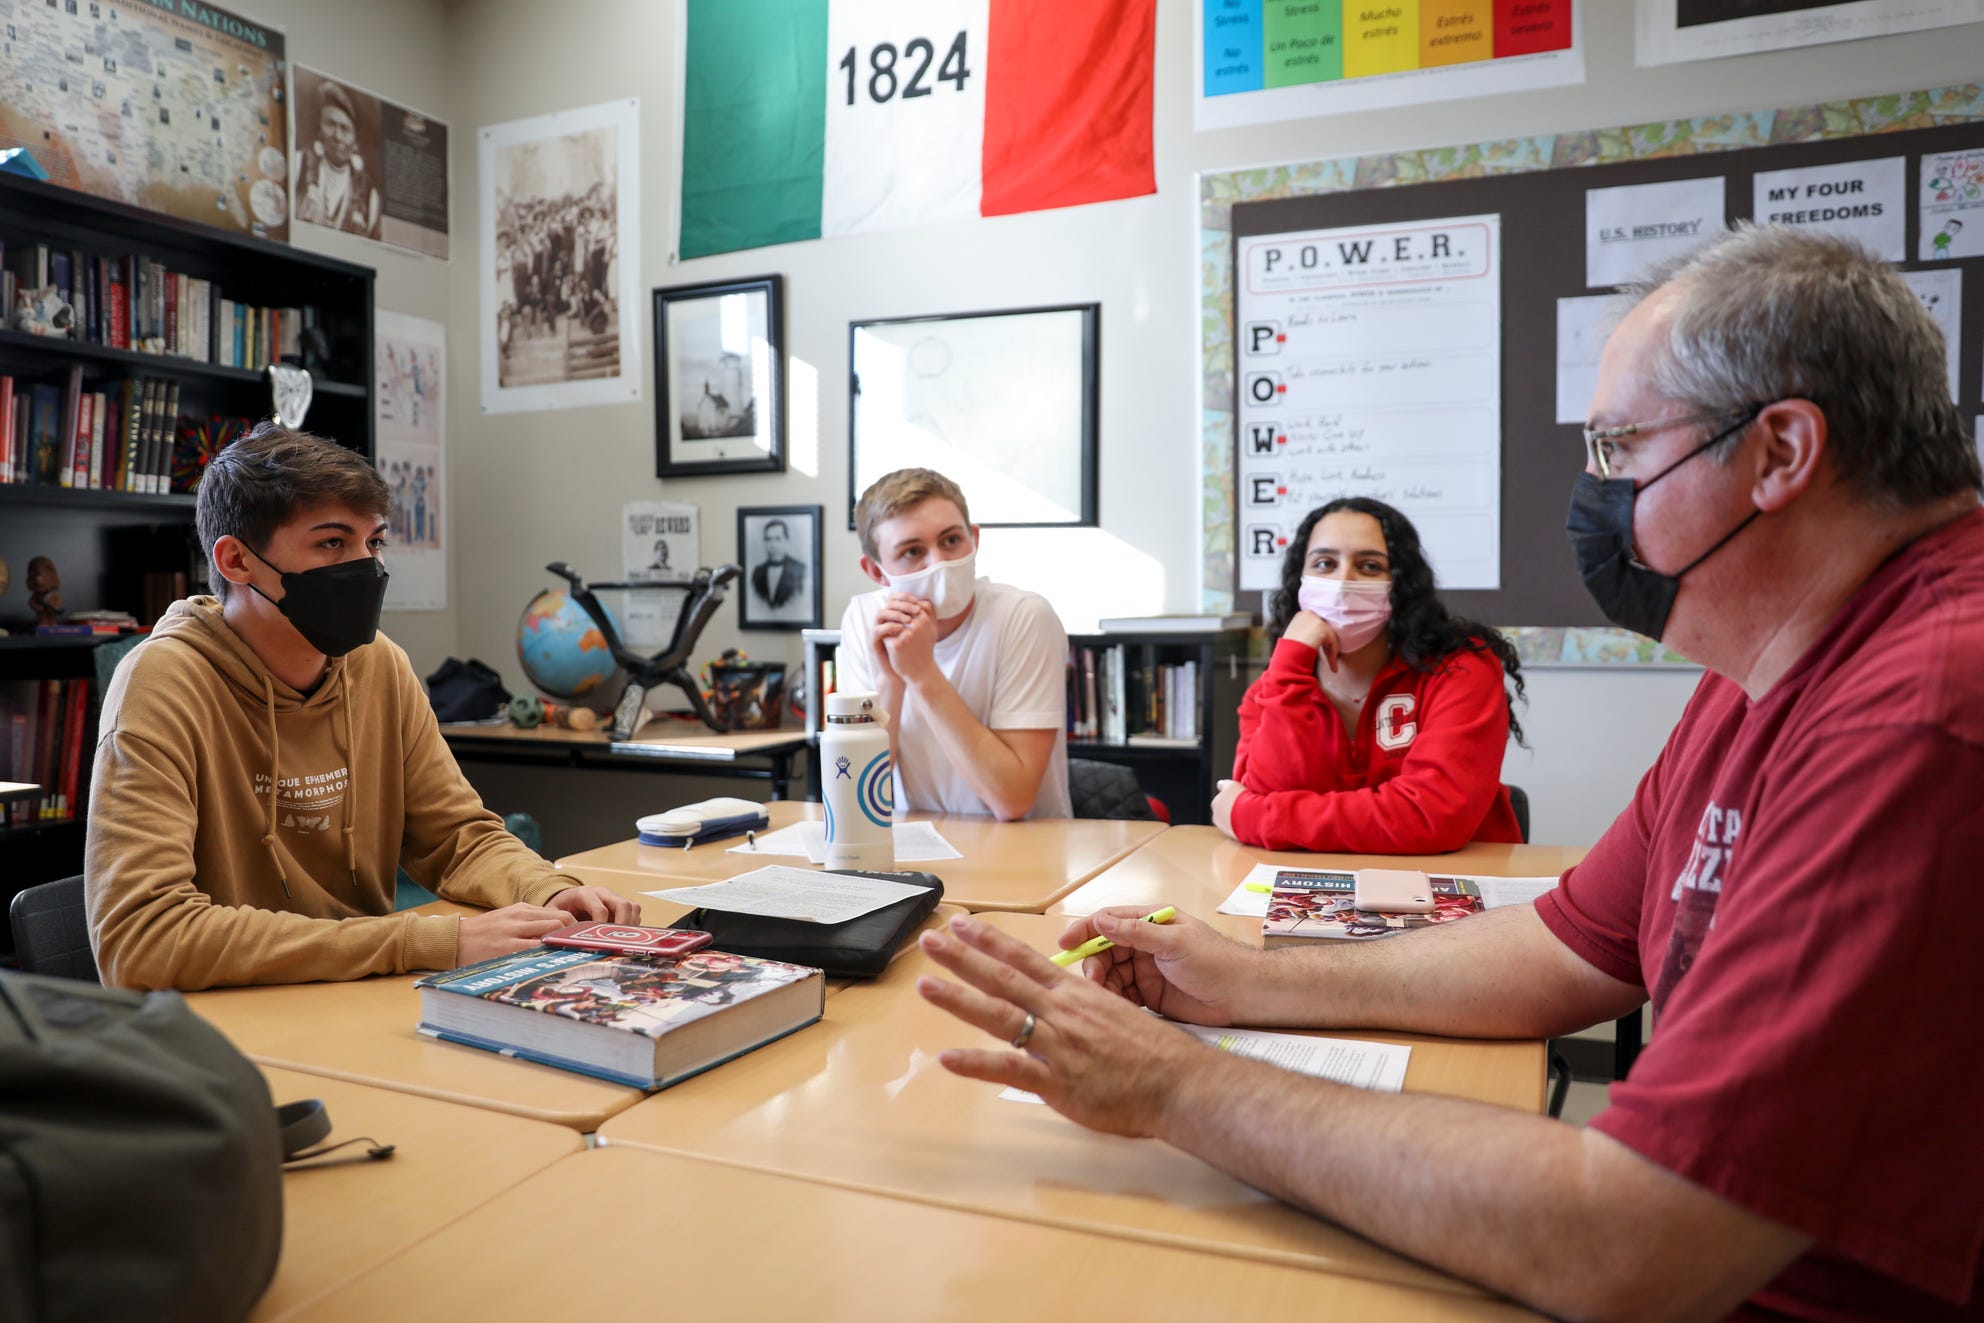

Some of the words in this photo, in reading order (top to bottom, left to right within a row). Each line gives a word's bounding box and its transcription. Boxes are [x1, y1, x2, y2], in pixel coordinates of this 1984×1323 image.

[179, 0, 267, 48] NATIONS
[1359, 7, 1402, 21] Mucho
[840, 30, 970, 105] 1824
[1769, 186, 1798, 200] MY
[1807, 180, 1864, 198] FOUR
[1770, 203, 1883, 224] FREEDOMS
[1252, 326, 1274, 351] P
[1253, 377, 1274, 402] O
[1252, 428, 1275, 453] W
[1253, 479, 1274, 503] E
[1254, 530, 1274, 554] R
[1376, 693, 1417, 751] C
[255, 773, 300, 788] UNQUE
[1281, 879, 1351, 889] HISTORY
[463, 966, 540, 991] HISTORY
